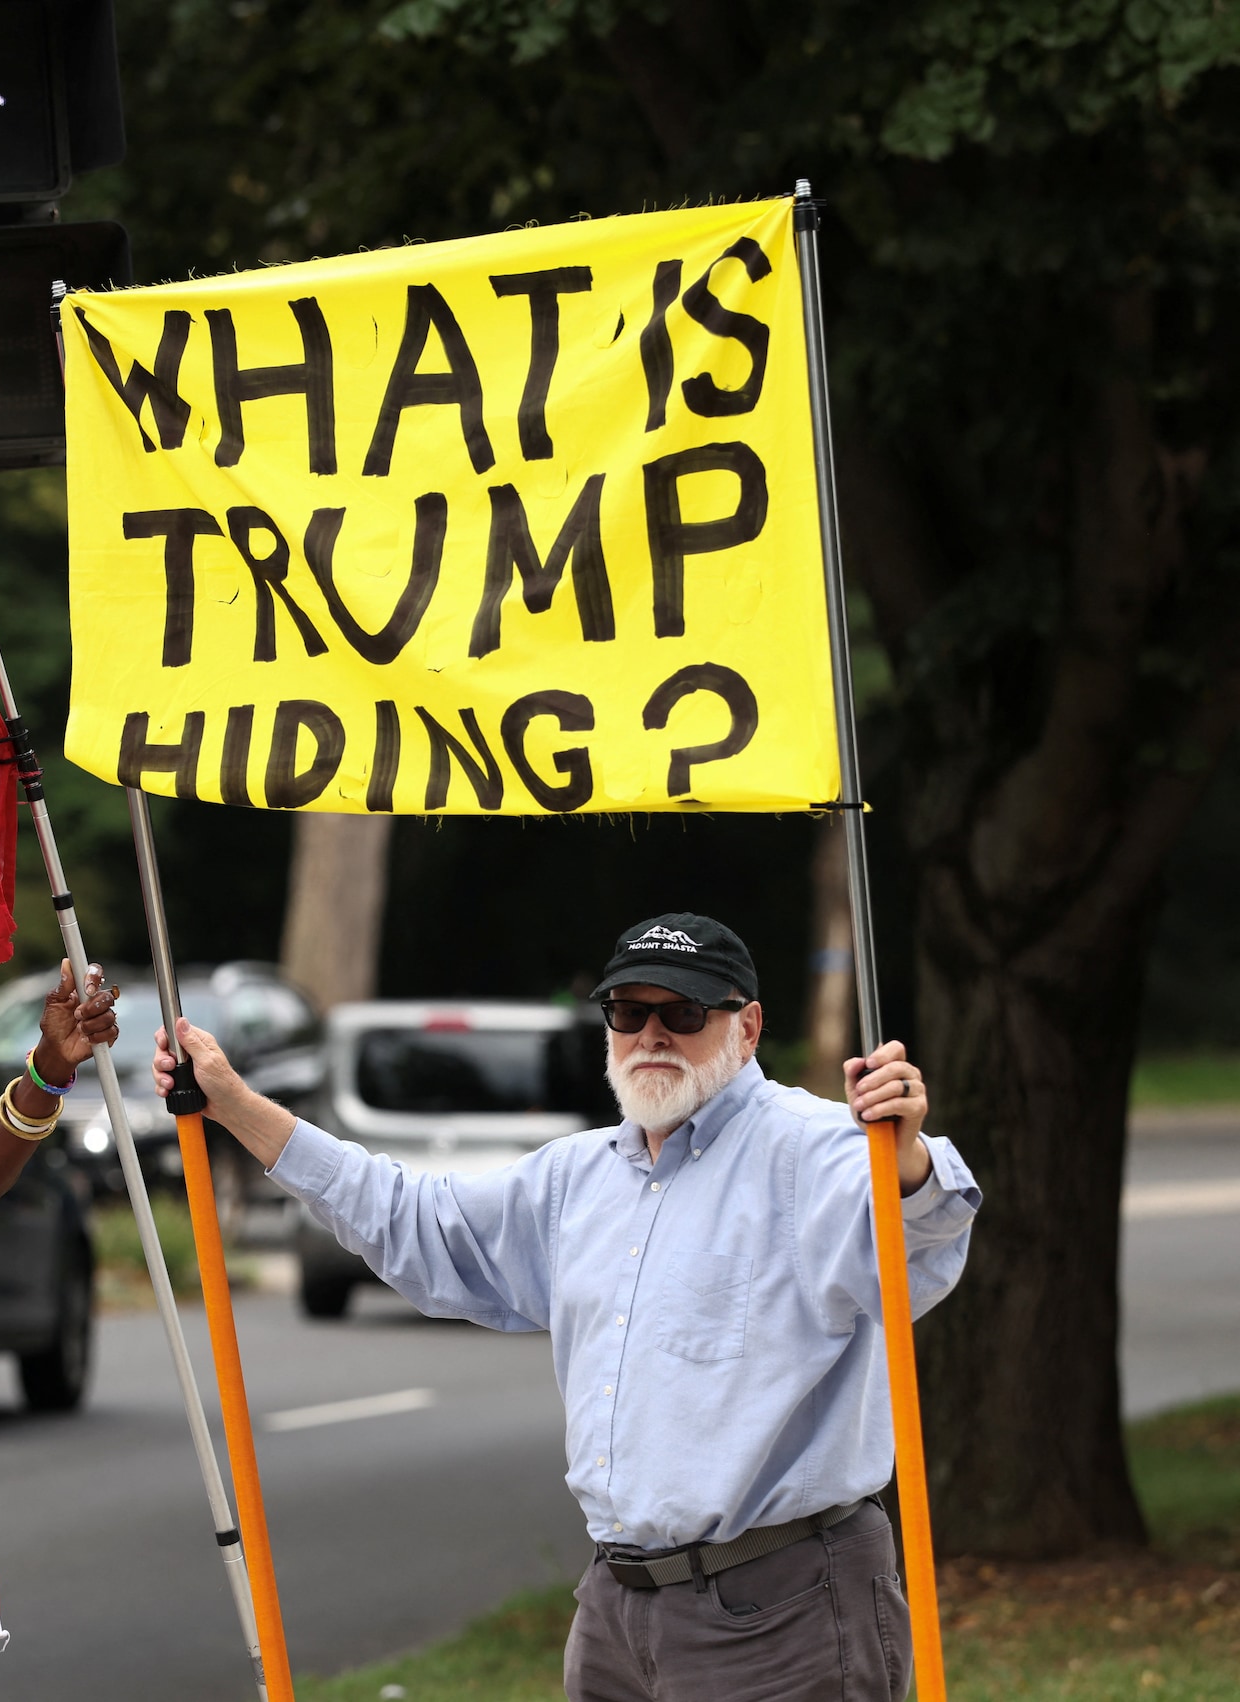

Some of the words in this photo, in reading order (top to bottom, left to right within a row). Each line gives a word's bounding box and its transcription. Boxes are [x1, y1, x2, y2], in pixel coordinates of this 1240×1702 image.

[74, 266, 593, 477] WHAT
[640, 235, 772, 432] IS
[122, 442, 769, 667] TRUMP
[117, 689, 596, 813] HIDING
[642, 661, 759, 798] ?
[628, 942, 661, 951] MOUNT
[662, 942, 698, 953] SHASTA
